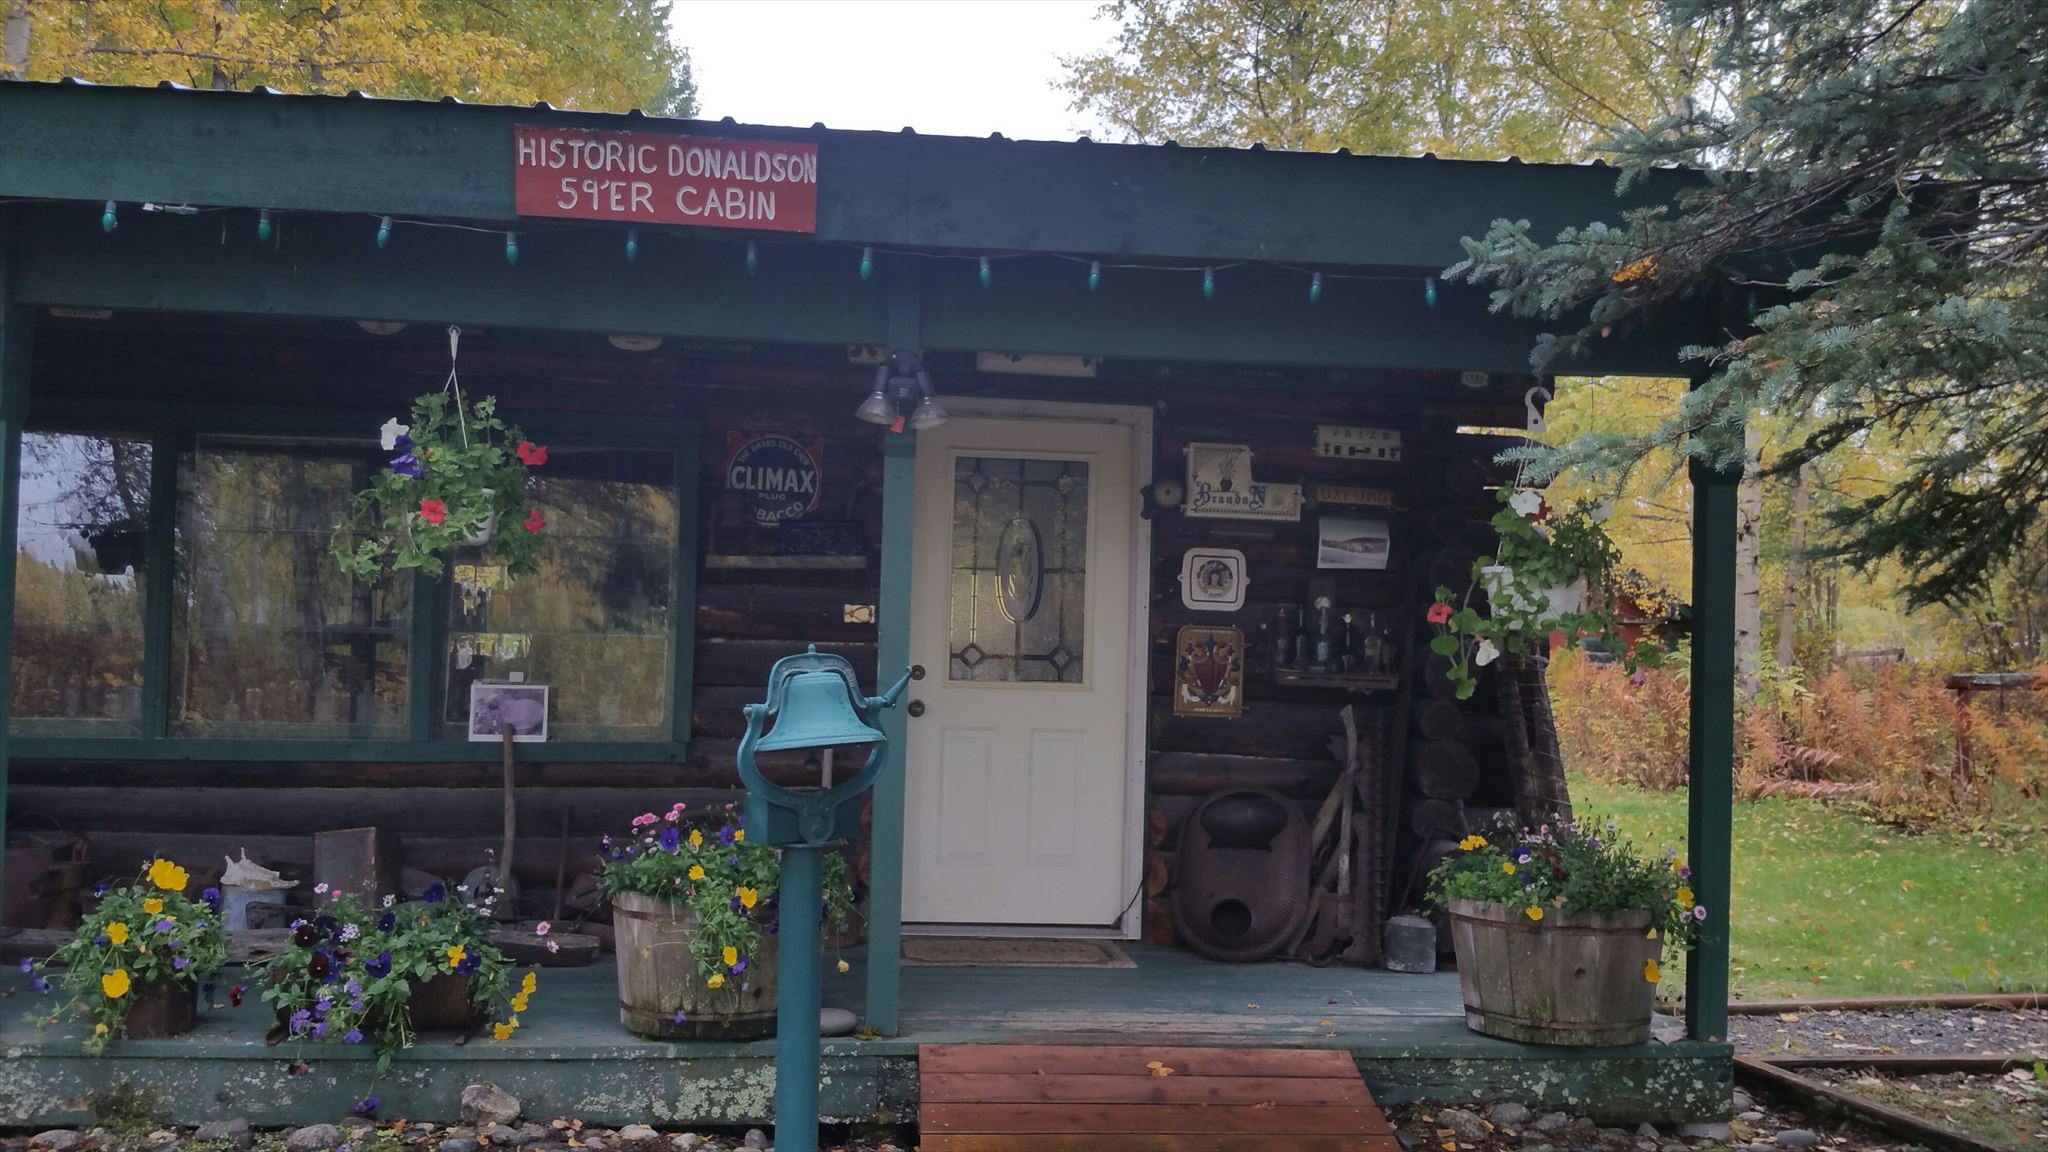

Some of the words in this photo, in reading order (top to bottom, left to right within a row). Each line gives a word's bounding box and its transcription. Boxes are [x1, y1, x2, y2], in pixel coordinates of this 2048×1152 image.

[518, 136, 657, 174] HISTORIC
[668, 144, 817, 183] DONALDSON
[557, 176, 655, 214] 59'ER
[676, 185, 776, 220] CABIN
[731, 465, 816, 493] CLIMAX
[758, 492, 787, 501] PLUG
